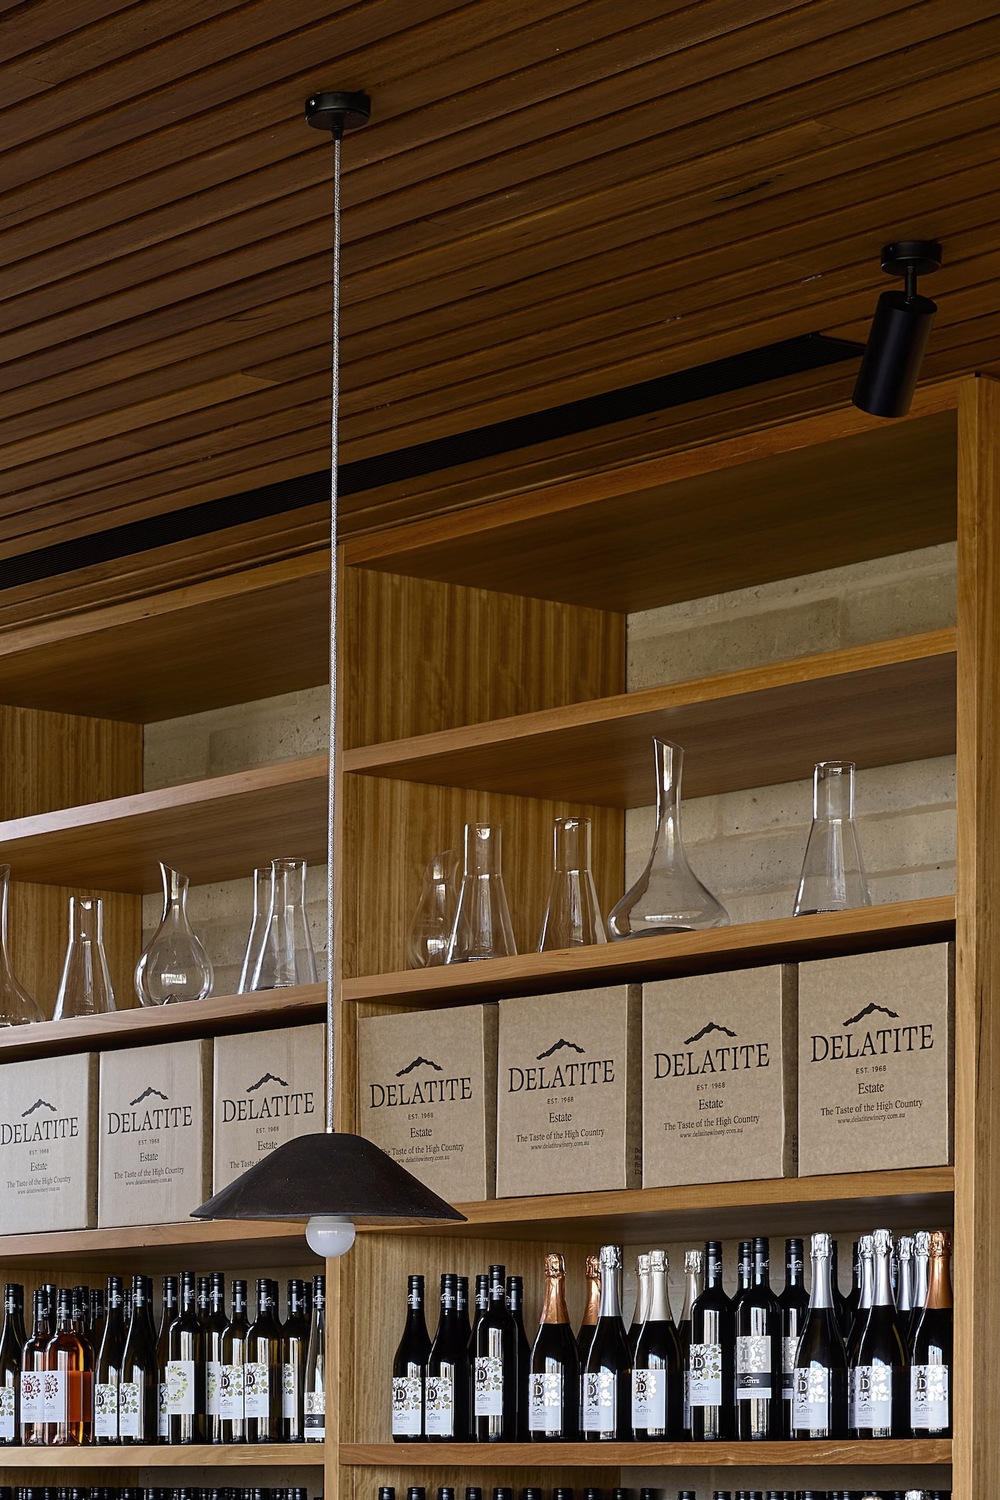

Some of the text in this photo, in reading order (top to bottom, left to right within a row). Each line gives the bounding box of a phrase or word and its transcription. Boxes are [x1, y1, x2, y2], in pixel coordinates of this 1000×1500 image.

[811, 1024, 934, 1062] DELATITE
[654, 1043, 770, 1079] DELATITE
[508, 1060, 615, 1092] DELATITE
[370, 1077, 472, 1108] DELATITE
[858, 1083, 884, 1094] Estate
[222, 1092, 315, 1122] DELATITE
[699, 1099, 724, 1110] Estate
[821, 1099, 923, 1116] The Taste of the High Country
[108, 1106, 193, 1134] DELATITE
[549, 1112, 572, 1123] Estate
[664, 1115, 759, 1131] The Taste of the High Country
[0, 1117, 79, 1145] DELATITE
[410, 1128, 432, 1138] Estate
[546, 1132, 553, 1140] of
[554, 1131, 563, 1139] the
[565, 1130, 579, 1139] High
[581, 1129, 604, 1137] Country
[258, 1141, 277, 1150] Estate
[392, 1147, 407, 1155] Taste
[408, 1146, 414, 1154] of
[426, 1144, 439, 1154] High
[441, 1144, 464, 1153] Country
[140, 1152, 158, 1162] Estate
[30, 1162, 47, 1171] Estate
[153, 1168, 164, 1177] High
[165, 1167, 184, 1175] Country
[42, 1177, 52, 1186] High
[54, 1176, 71, 1184] Country
